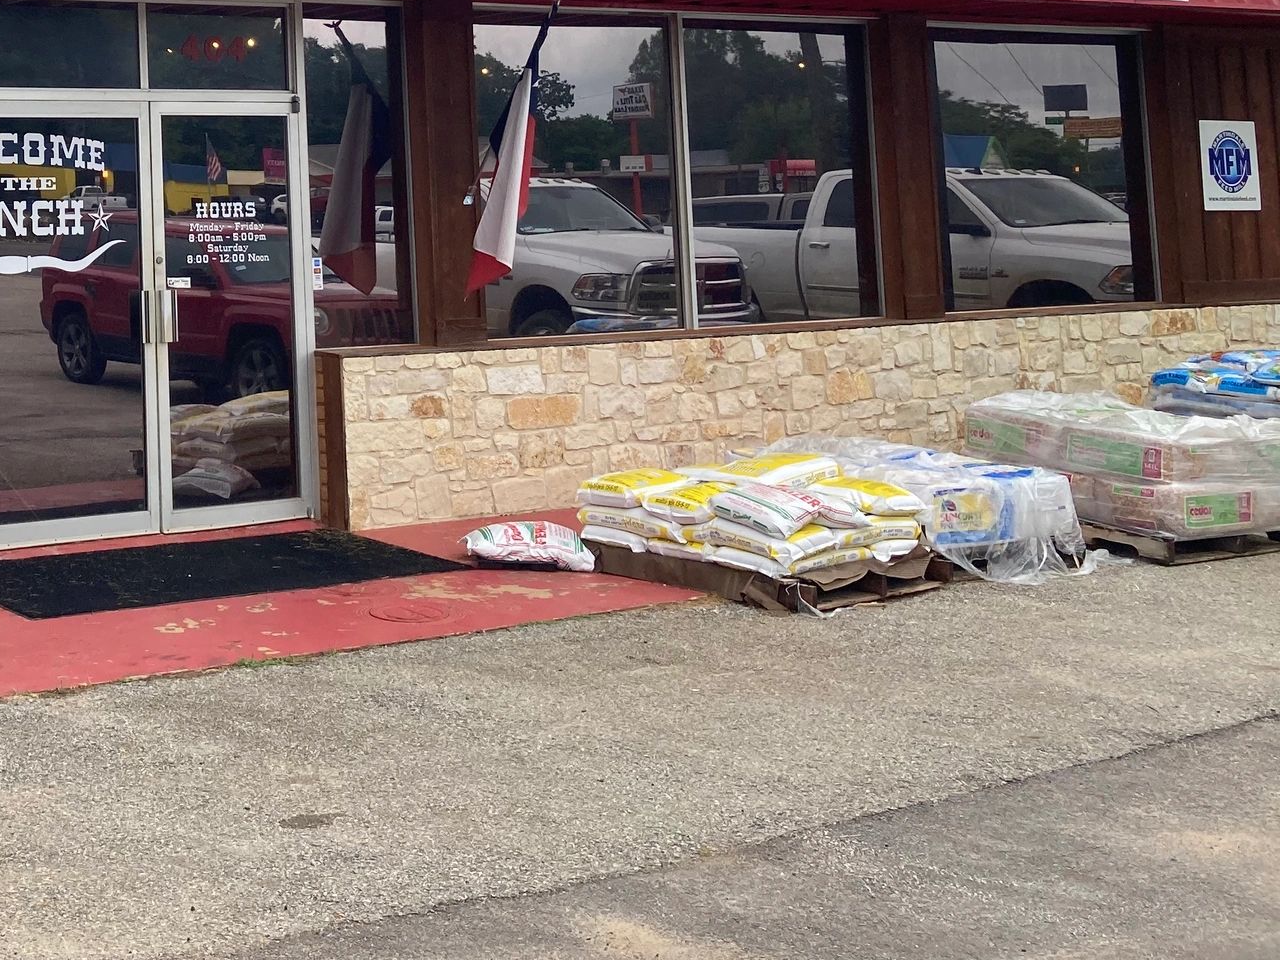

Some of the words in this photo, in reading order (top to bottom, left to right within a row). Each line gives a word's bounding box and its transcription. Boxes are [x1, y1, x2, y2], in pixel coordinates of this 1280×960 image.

[1208, 148, 1252, 175] MFM
[0, 176, 57, 191] THE
[195, 202, 257, 219] HOURS
[189, 223, 225, 232] Monday
[234, 222, 264, 231] Friday
[188, 233, 223, 242] 8:00am
[233, 232, 267, 242] 5:00pm
[207, 244, 249, 253] Saturday
[186, 254, 209, 264] 8:00
[219, 254, 245, 263] 12:00
[248, 253, 270, 262] Noon
